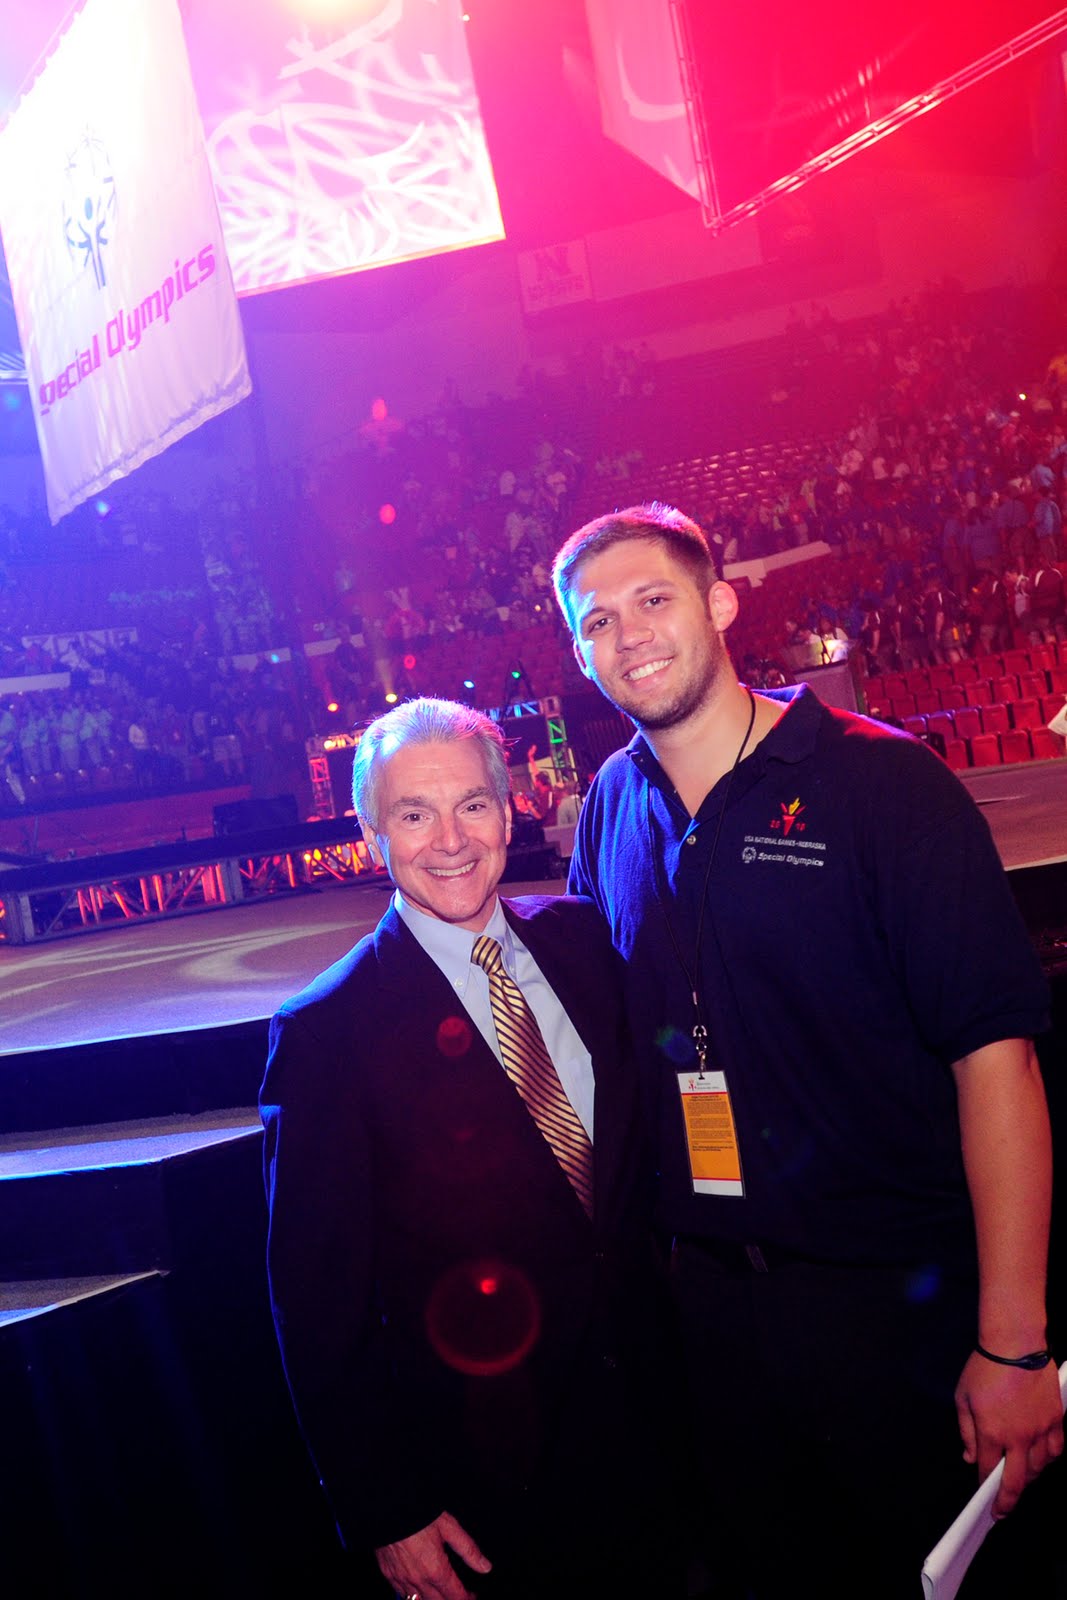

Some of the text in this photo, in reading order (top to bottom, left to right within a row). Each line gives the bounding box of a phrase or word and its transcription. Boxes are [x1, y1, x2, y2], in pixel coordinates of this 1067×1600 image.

[39, 243, 216, 416] pecial Olympics
[758, 852, 824, 867] Special Olympics
